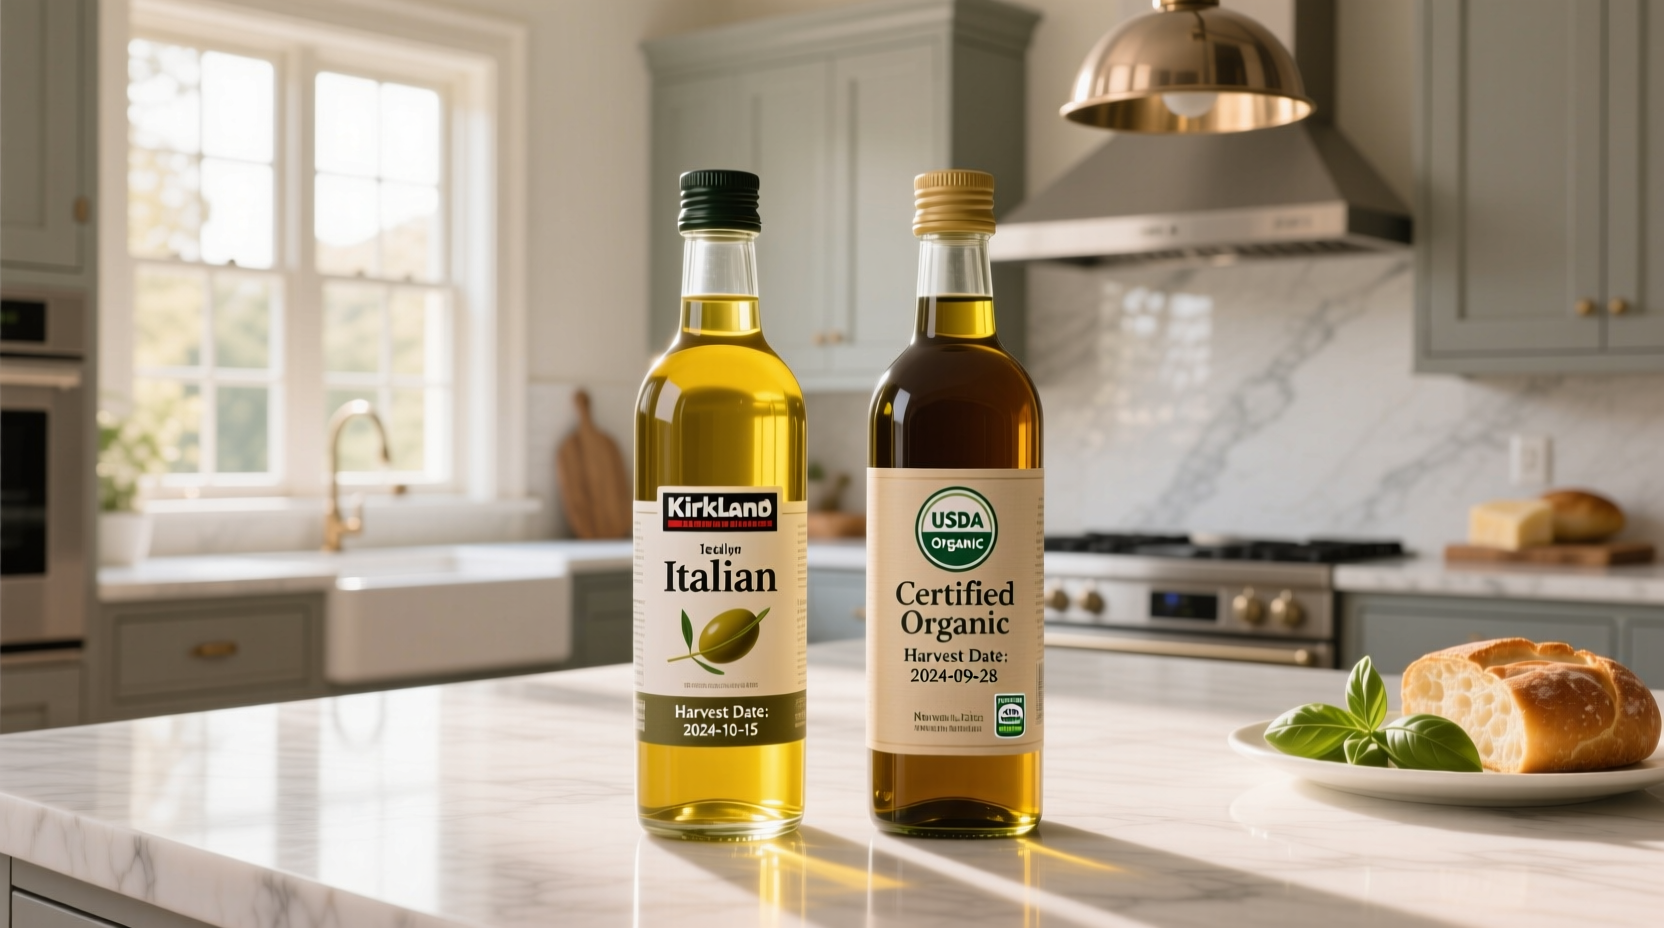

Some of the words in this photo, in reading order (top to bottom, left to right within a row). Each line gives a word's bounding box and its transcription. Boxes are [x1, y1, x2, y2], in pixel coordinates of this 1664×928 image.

[931, 511, 984, 529] USDA
[664, 559, 778, 593] Italian
[895, 580, 1015, 606] Certified
[901, 610, 1010, 643] Organic
[904, 648, 964, 663] Harvest
[969, 649, 1008, 664] Date:
[910, 668, 998, 684] 2024-09-28
[675, 705, 729, 719] Harvest
[733, 705, 769, 719] Date:
[683, 723, 759, 737] 2024-10-15
